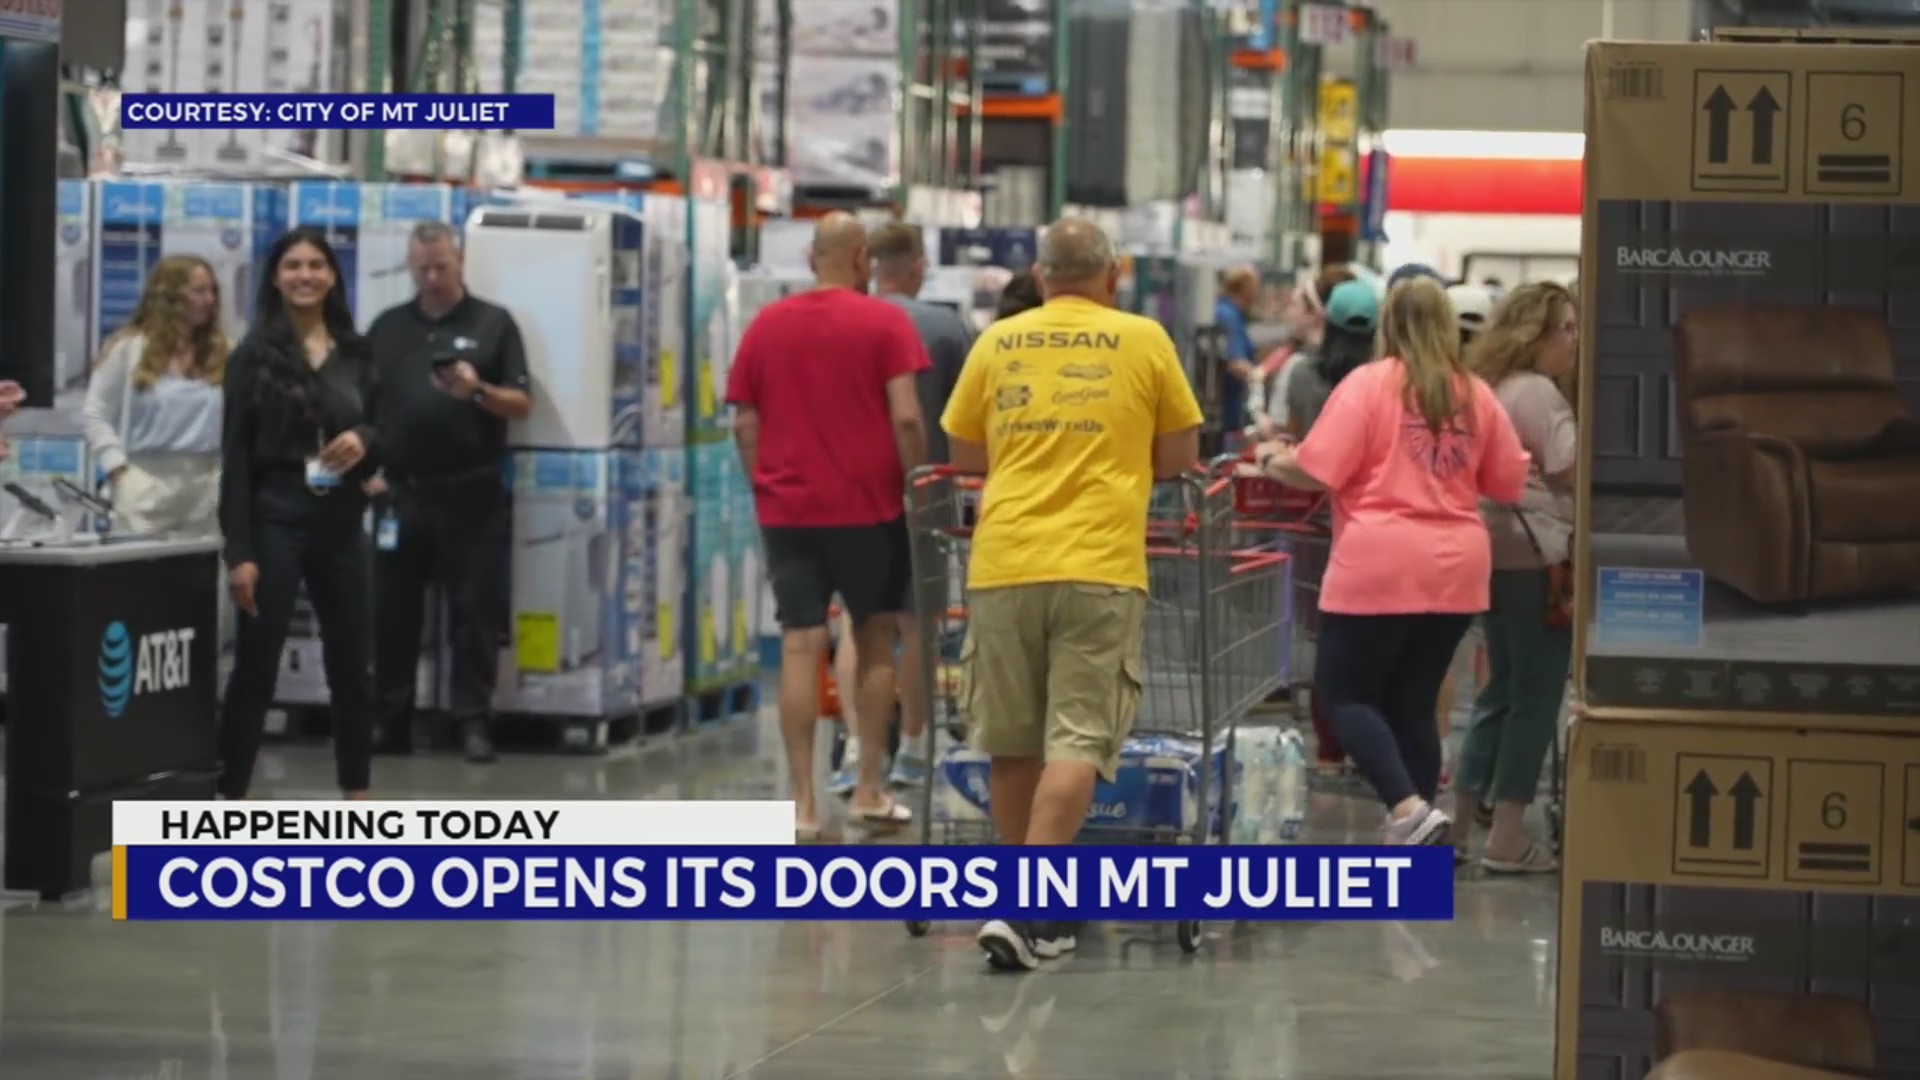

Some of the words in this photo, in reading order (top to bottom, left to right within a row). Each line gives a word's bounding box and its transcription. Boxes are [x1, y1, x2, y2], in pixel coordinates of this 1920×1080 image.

[1841, 103, 1867, 141] 6
[995, 331, 1121, 353] NISSAN
[134, 626, 196, 695] AT&T
[1821, 792, 1847, 830] 6
